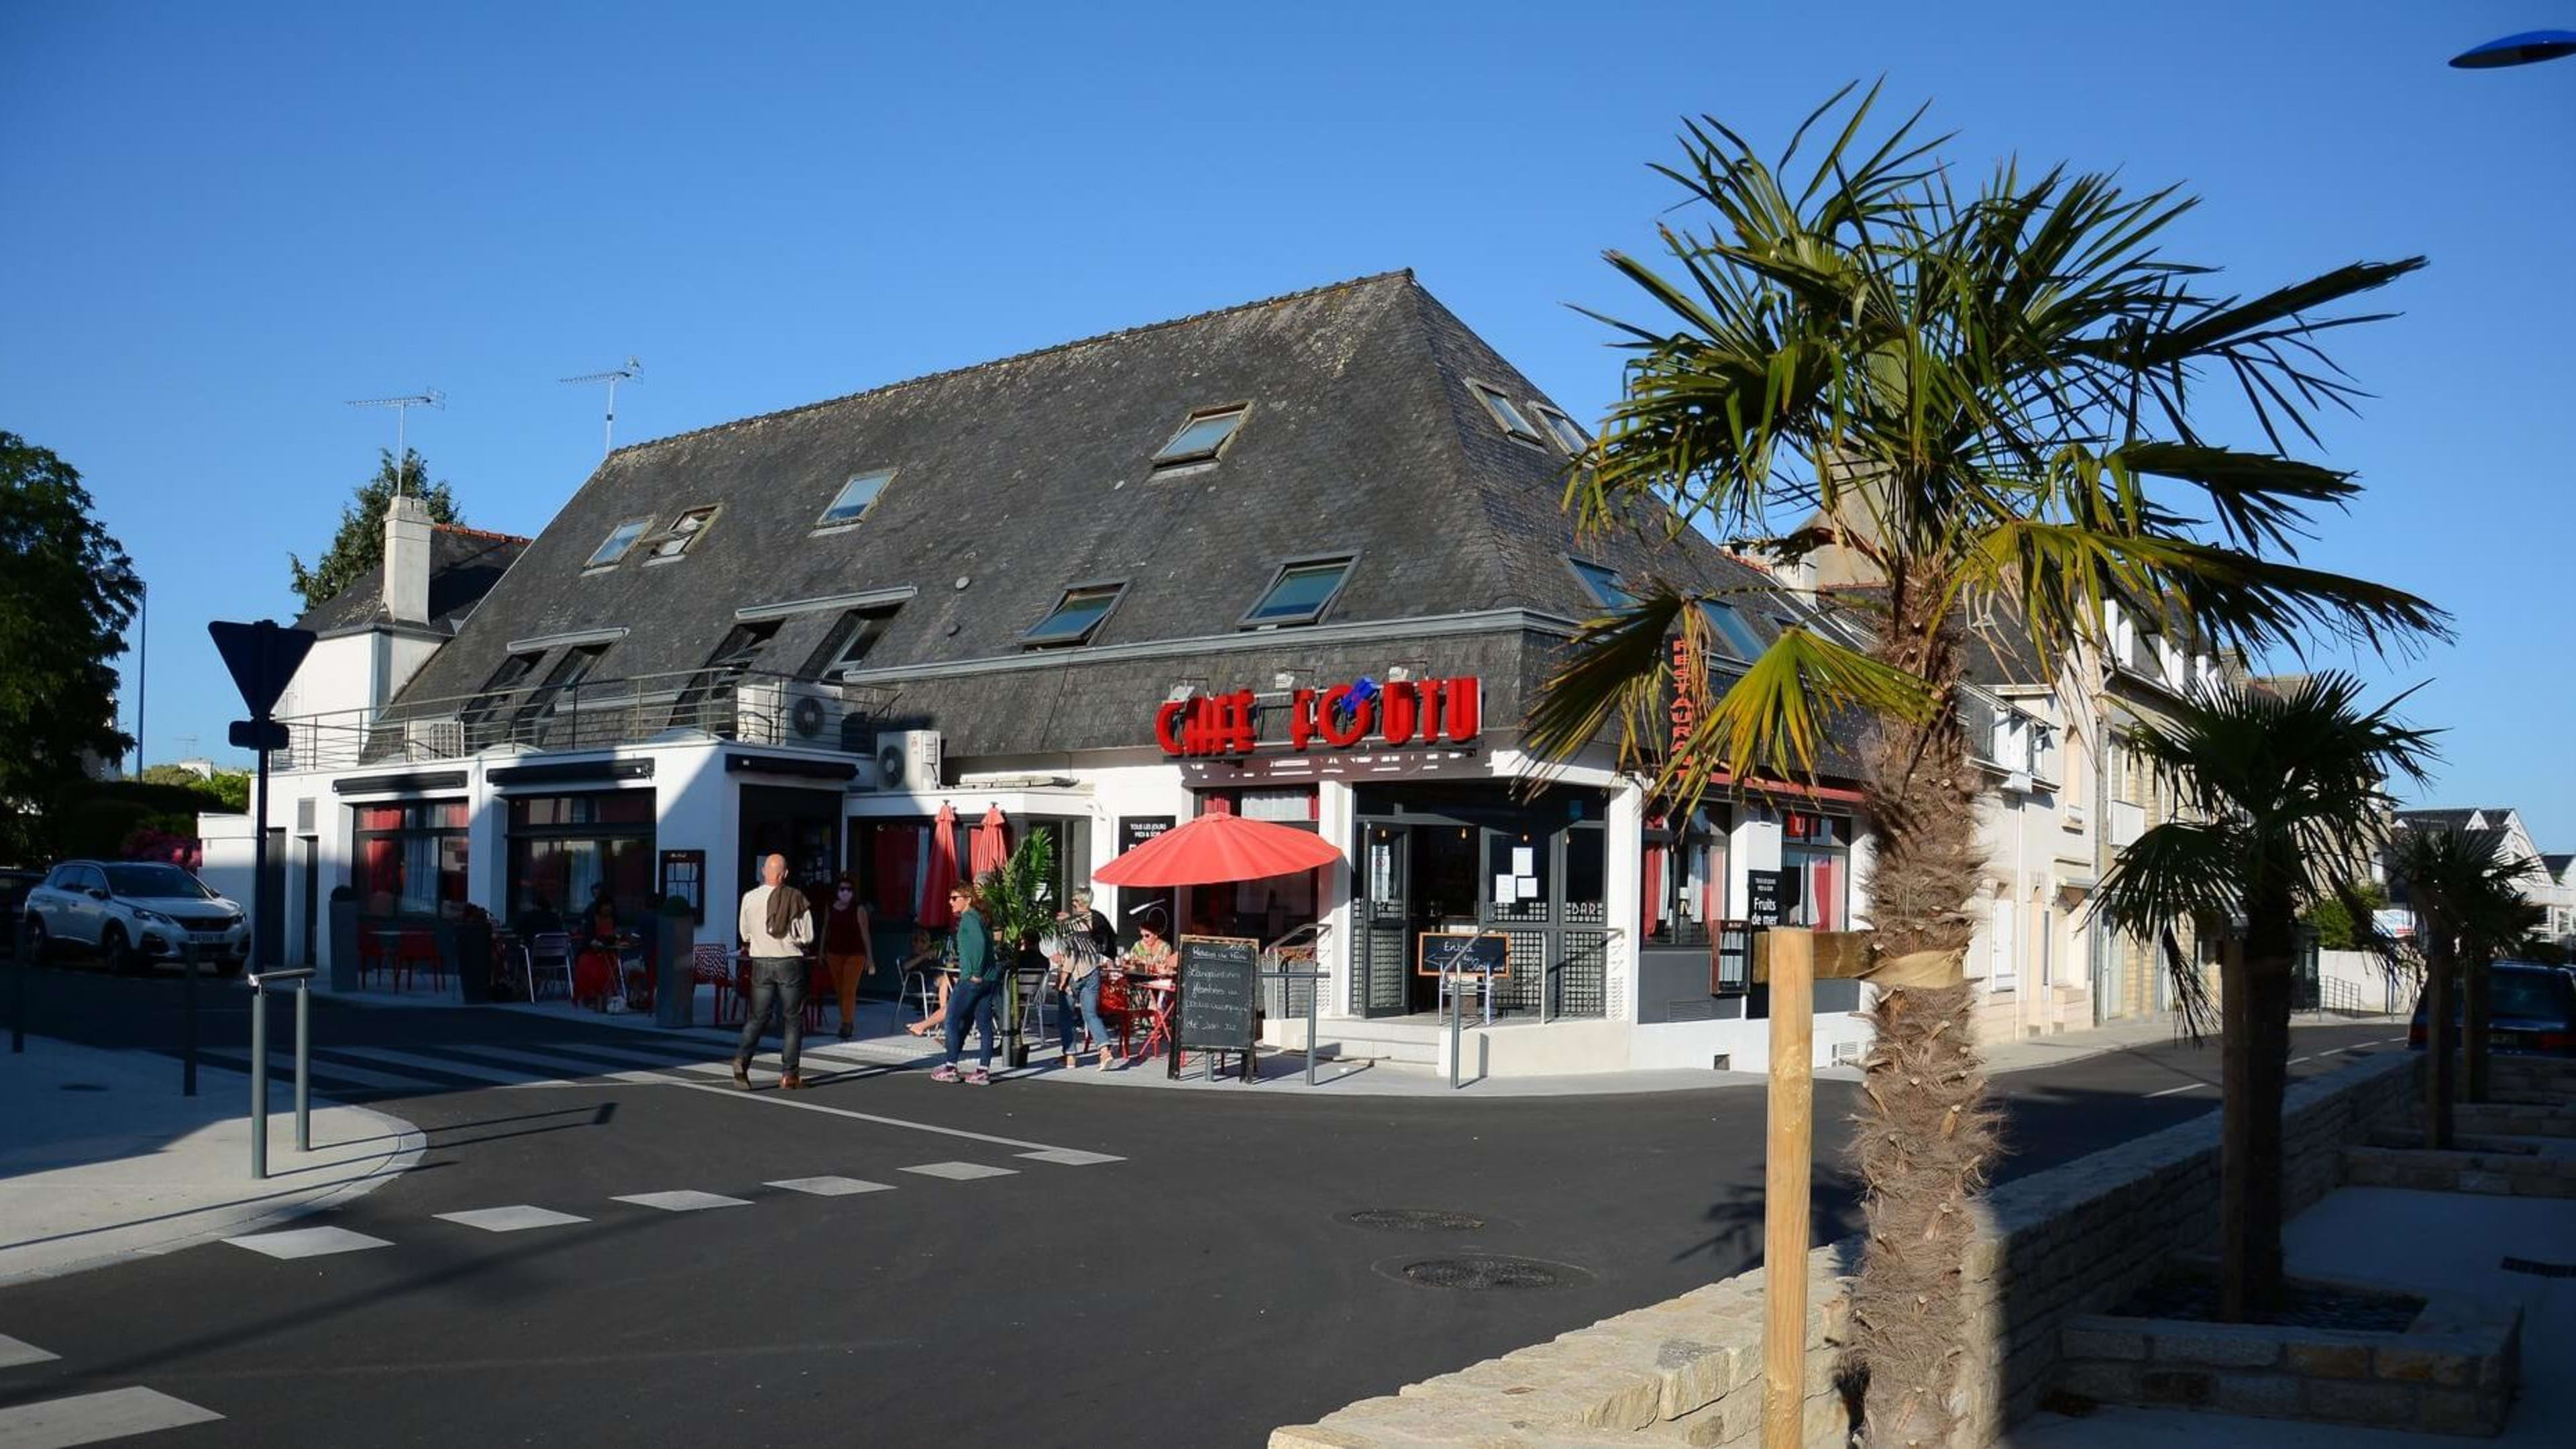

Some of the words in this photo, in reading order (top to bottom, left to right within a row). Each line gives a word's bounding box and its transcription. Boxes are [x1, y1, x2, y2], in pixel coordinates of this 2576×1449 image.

[1754, 897, 1776, 910] Fruits
[1752, 912, 1762, 925] de
[1762, 915, 1779, 925] mer
